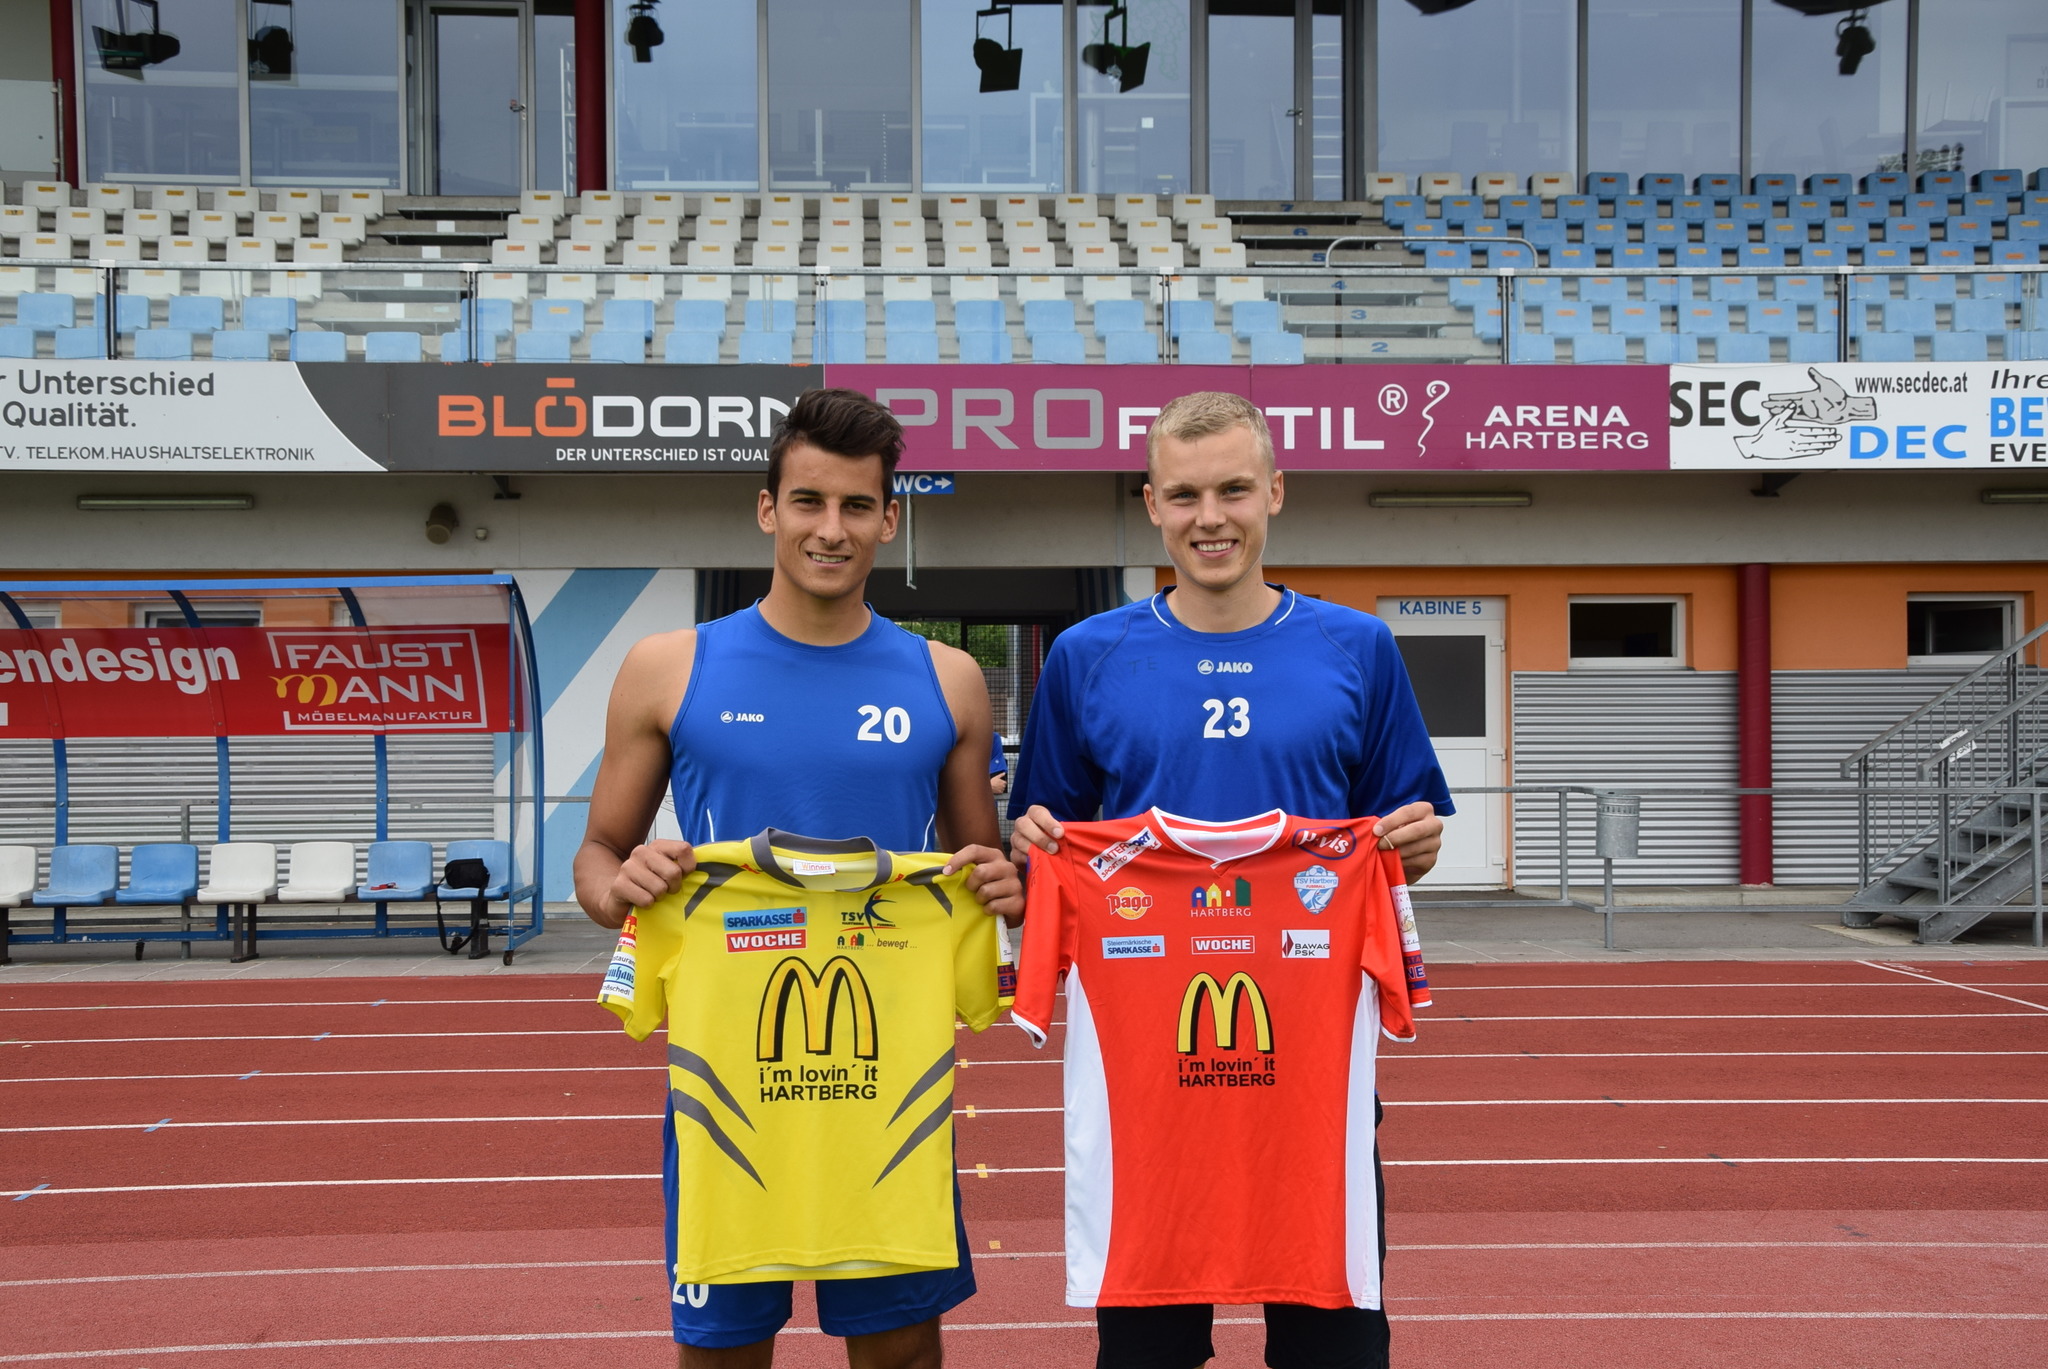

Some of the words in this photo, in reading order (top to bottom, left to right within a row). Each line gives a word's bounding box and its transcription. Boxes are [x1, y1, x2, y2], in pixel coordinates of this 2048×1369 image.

[1350, 309, 1367, 320] 3
[1371, 342, 1389, 353] 2
[18, 369, 215, 397] Unterschied
[1855, 371, 1968, 394] www.secdec.at
[1669, 380, 1761, 427] SEC
[2, 400, 137, 429] Qualität.
[1484, 405, 1630, 427] ARENA
[1990, 397, 2048, 438] BE
[1465, 431, 1650, 450] HARTBERG
[1849, 424, 1968, 460] DEC
[556, 448, 587, 462] DER
[591, 448, 699, 462] UNTERSCHIED
[703, 448, 727, 462] IST
[730, 448, 770, 463] QUAL
[892, 474, 933, 493] WC
[1399, 600, 1467, 615] KABINE
[1472, 601, 1482, 615] 5
[285, 642, 464, 669] FAUST
[1216, 661, 1253, 673] JAKO
[297, 710, 473, 722] MÖBELMANUFAKTUR
[735, 712, 765, 723] JAKO
[1202, 696, 1251, 739] 23
[857, 704, 912, 744] 20
[1101, 860, 1119, 878] SPORT
[1119, 855, 1128, 863] TO
[1309, 877, 1338, 885] Hartberg
[1105, 893, 1154, 916] pago
[841, 911, 865, 922] TSV
[1190, 907, 1252, 918] HARTBERG
[727, 913, 793, 928] SPARKASSE
[730, 932, 803, 949] WOCHE
[876, 938, 909, 950] bewegt
[1106, 939, 1152, 947] Steiermärkische
[1195, 939, 1251, 951] WOCHE
[1107, 946, 1152, 955] SPARKASSE
[1294, 949, 1316, 957] PSK
[1264, 1057, 1276, 1071] it
[864, 1064, 879, 1082] it
[1178, 1073, 1276, 1087] HARTBERG
[760, 1083, 878, 1103] HARTBERG
